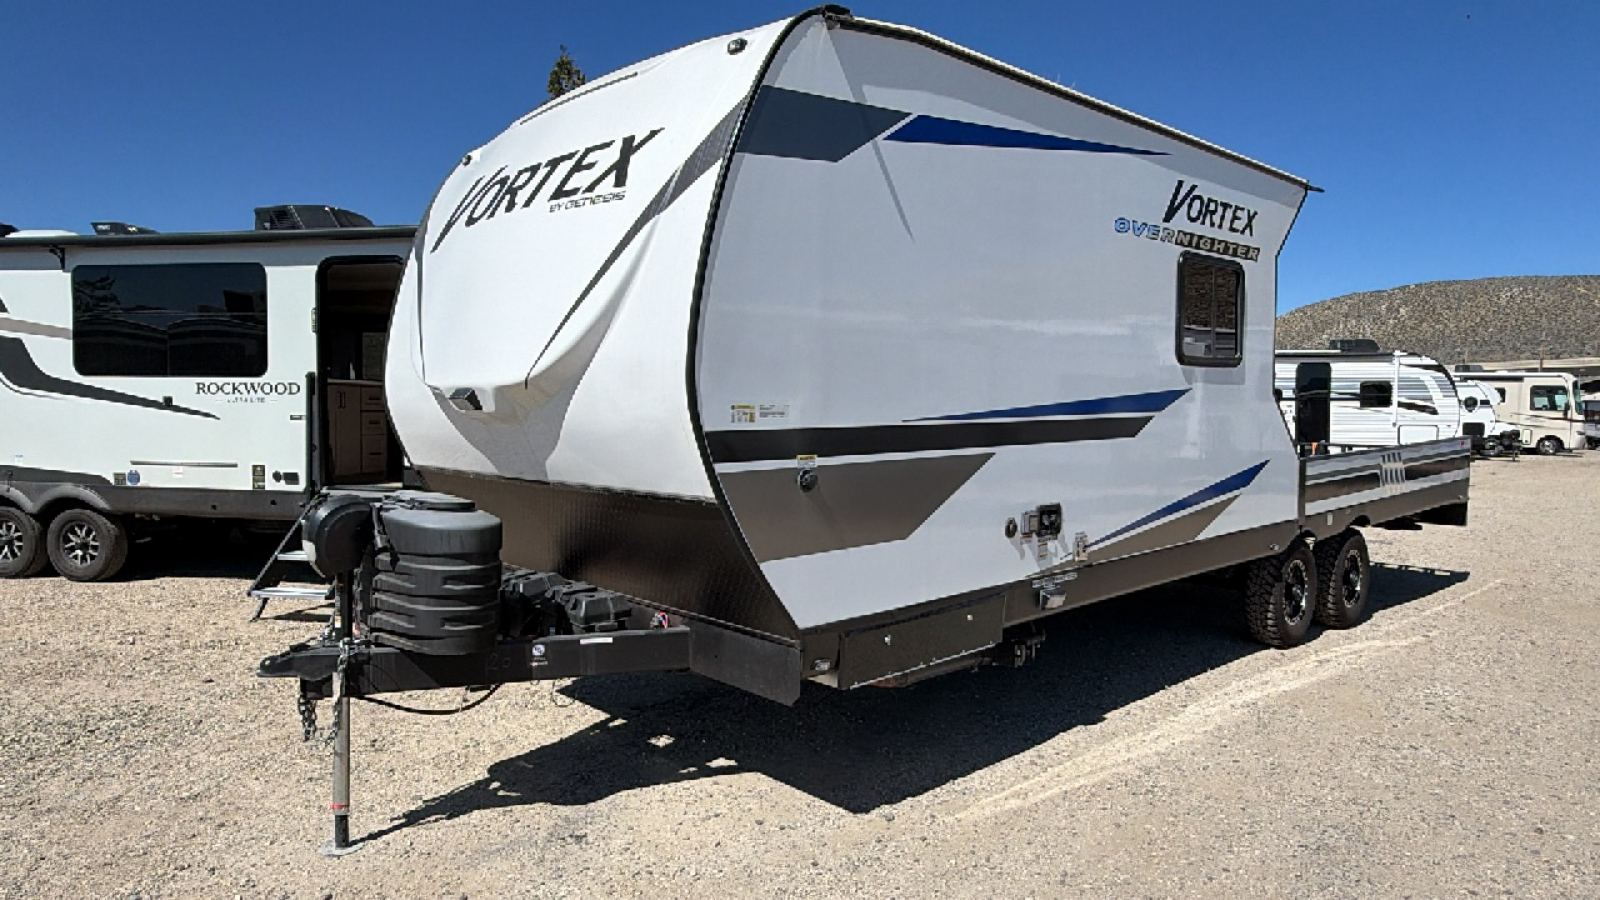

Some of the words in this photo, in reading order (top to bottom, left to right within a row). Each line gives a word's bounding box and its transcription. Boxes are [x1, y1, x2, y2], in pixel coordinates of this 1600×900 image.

[430, 127, 666, 254] VORTEX
[564, 190, 627, 210] GENESIS
[1162, 179, 1258, 237] VORTEX
[1114, 216, 1261, 262] OVERNIGHTER
[195, 382, 301, 395] ROCKWOOD
